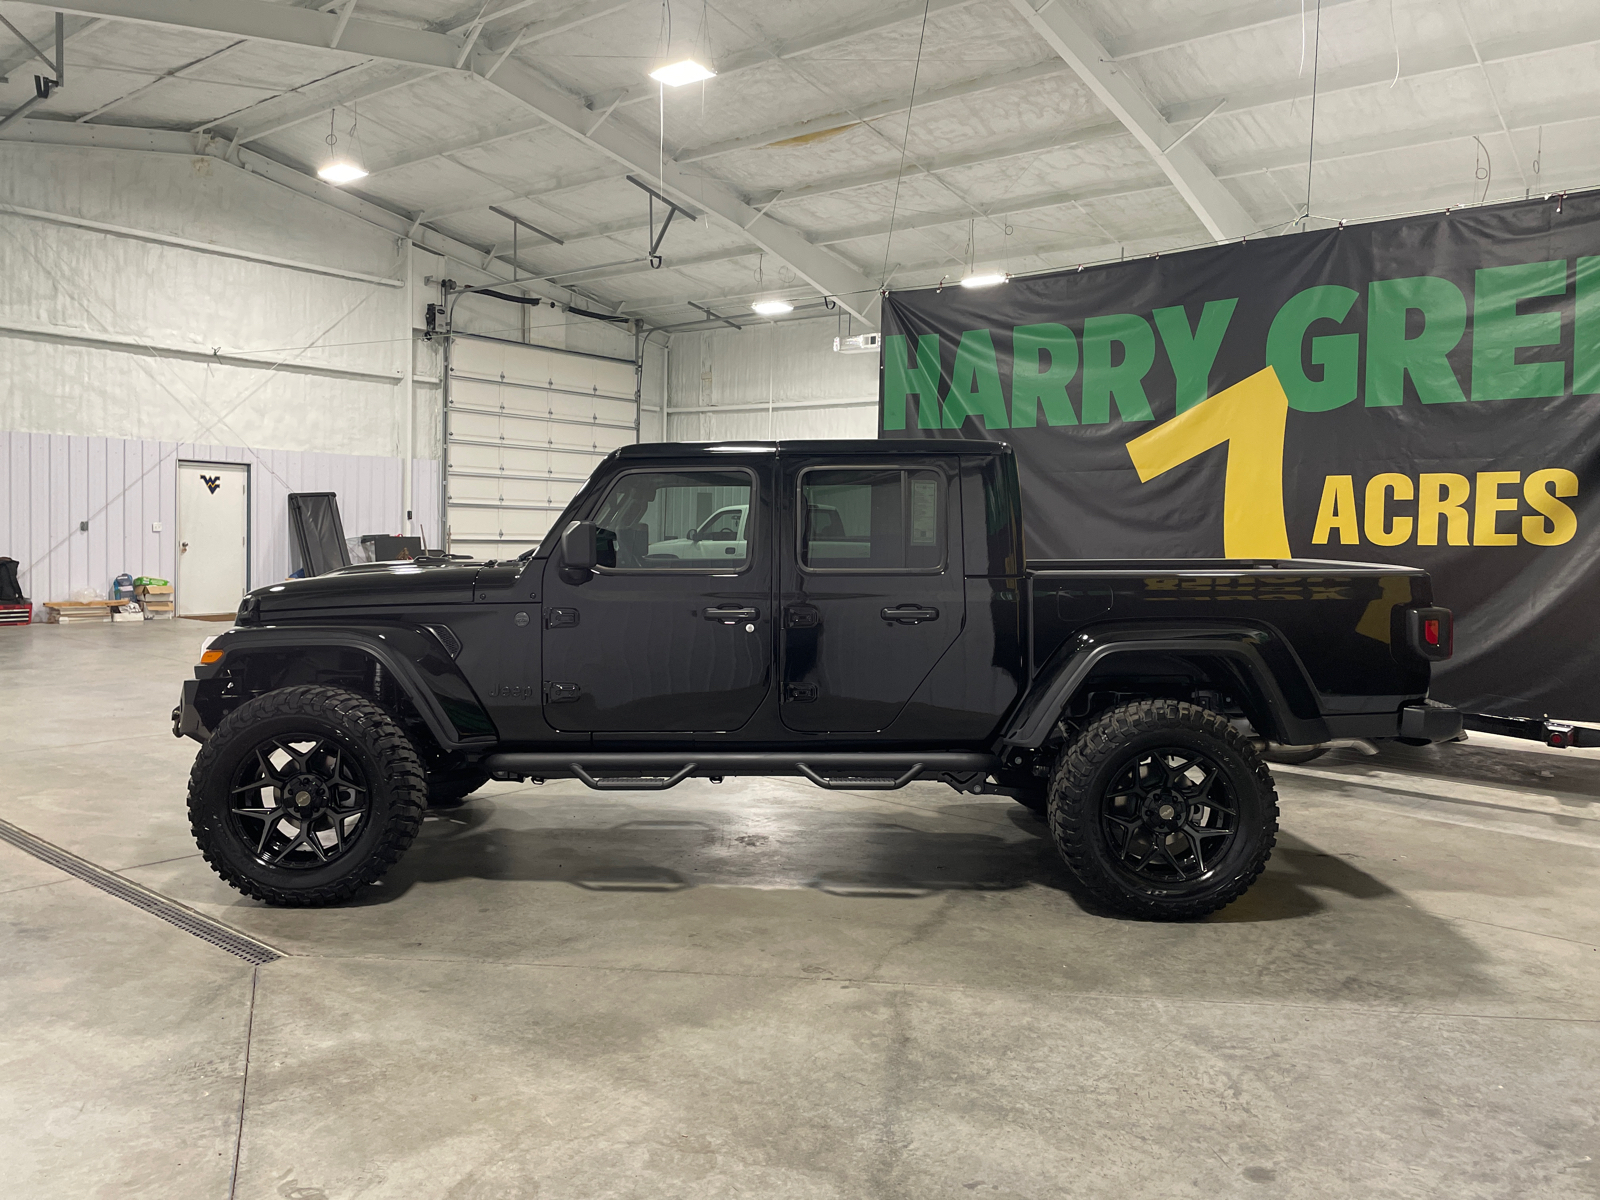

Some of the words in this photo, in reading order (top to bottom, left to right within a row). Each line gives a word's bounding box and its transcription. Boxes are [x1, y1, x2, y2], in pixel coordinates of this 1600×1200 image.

[883, 297, 1239, 431] HARRY
[1265, 255, 1600, 412] GRE
[1311, 467, 1579, 547] ACRES
[488, 683, 533, 700] Jeep
